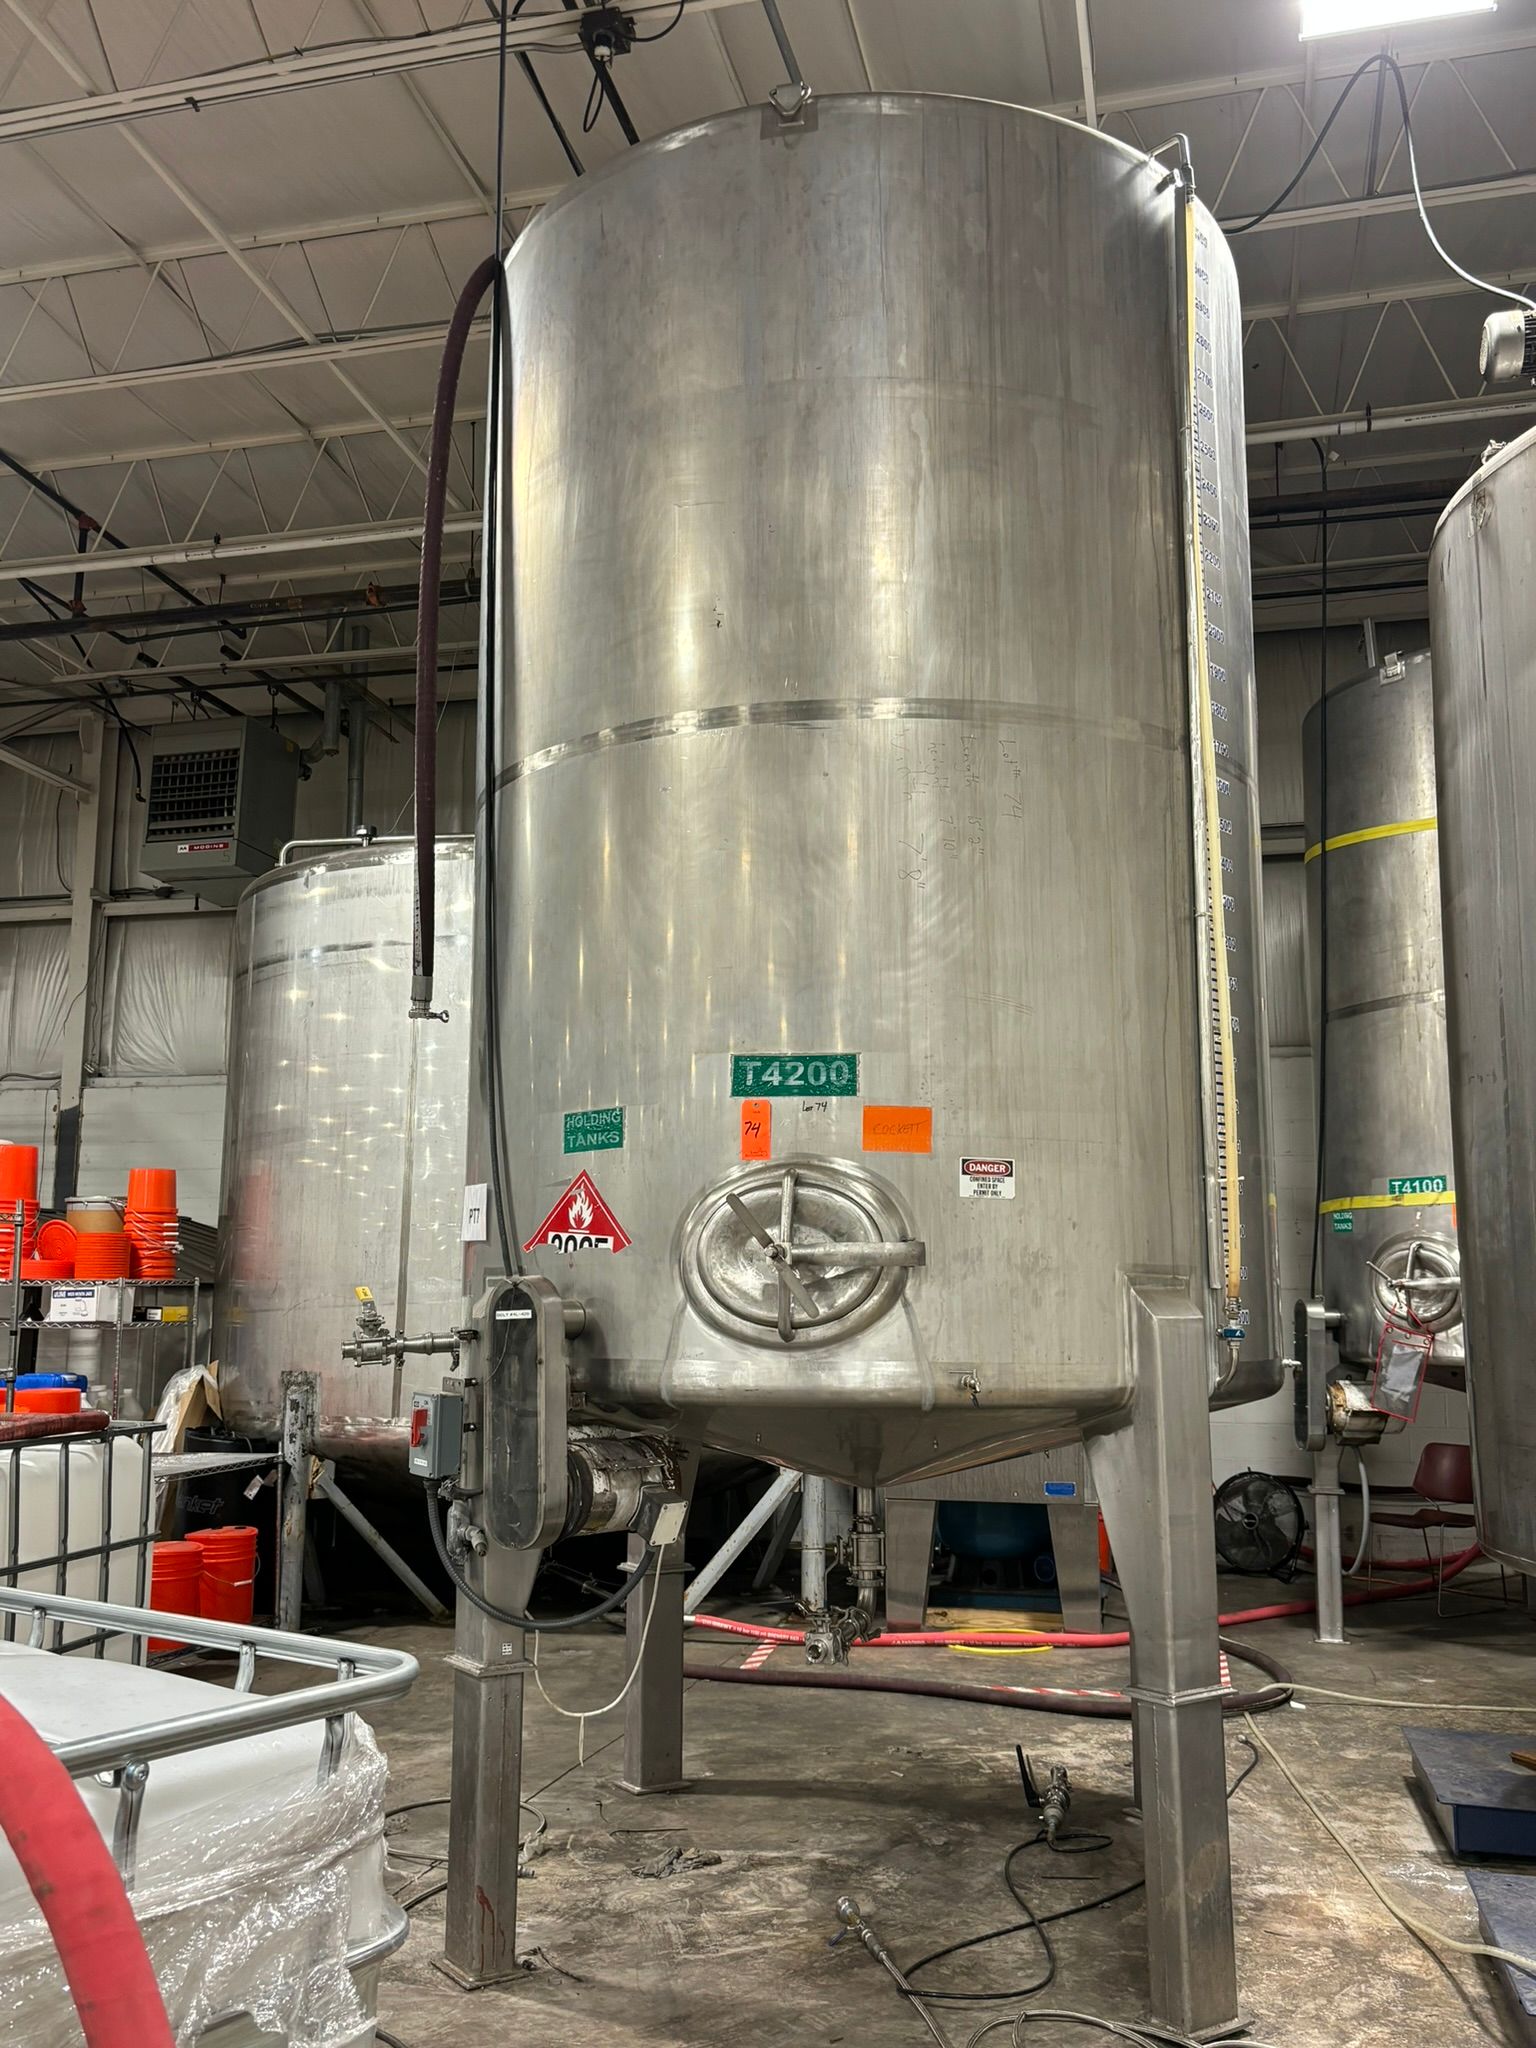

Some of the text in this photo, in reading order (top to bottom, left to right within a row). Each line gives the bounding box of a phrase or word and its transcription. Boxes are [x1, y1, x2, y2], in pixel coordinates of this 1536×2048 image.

[1001, 792, 1024, 819] 74
[738, 1060, 849, 1087] T4200
[815, 1101, 828, 1112] 74
[566, 1110, 621, 1128] HOLDING
[744, 1120, 761, 1138] 74
[567, 1131, 620, 1148] TANKS
[969, 1163, 1006, 1173] DANGER
[1391, 1178, 1443, 1194] T4100
